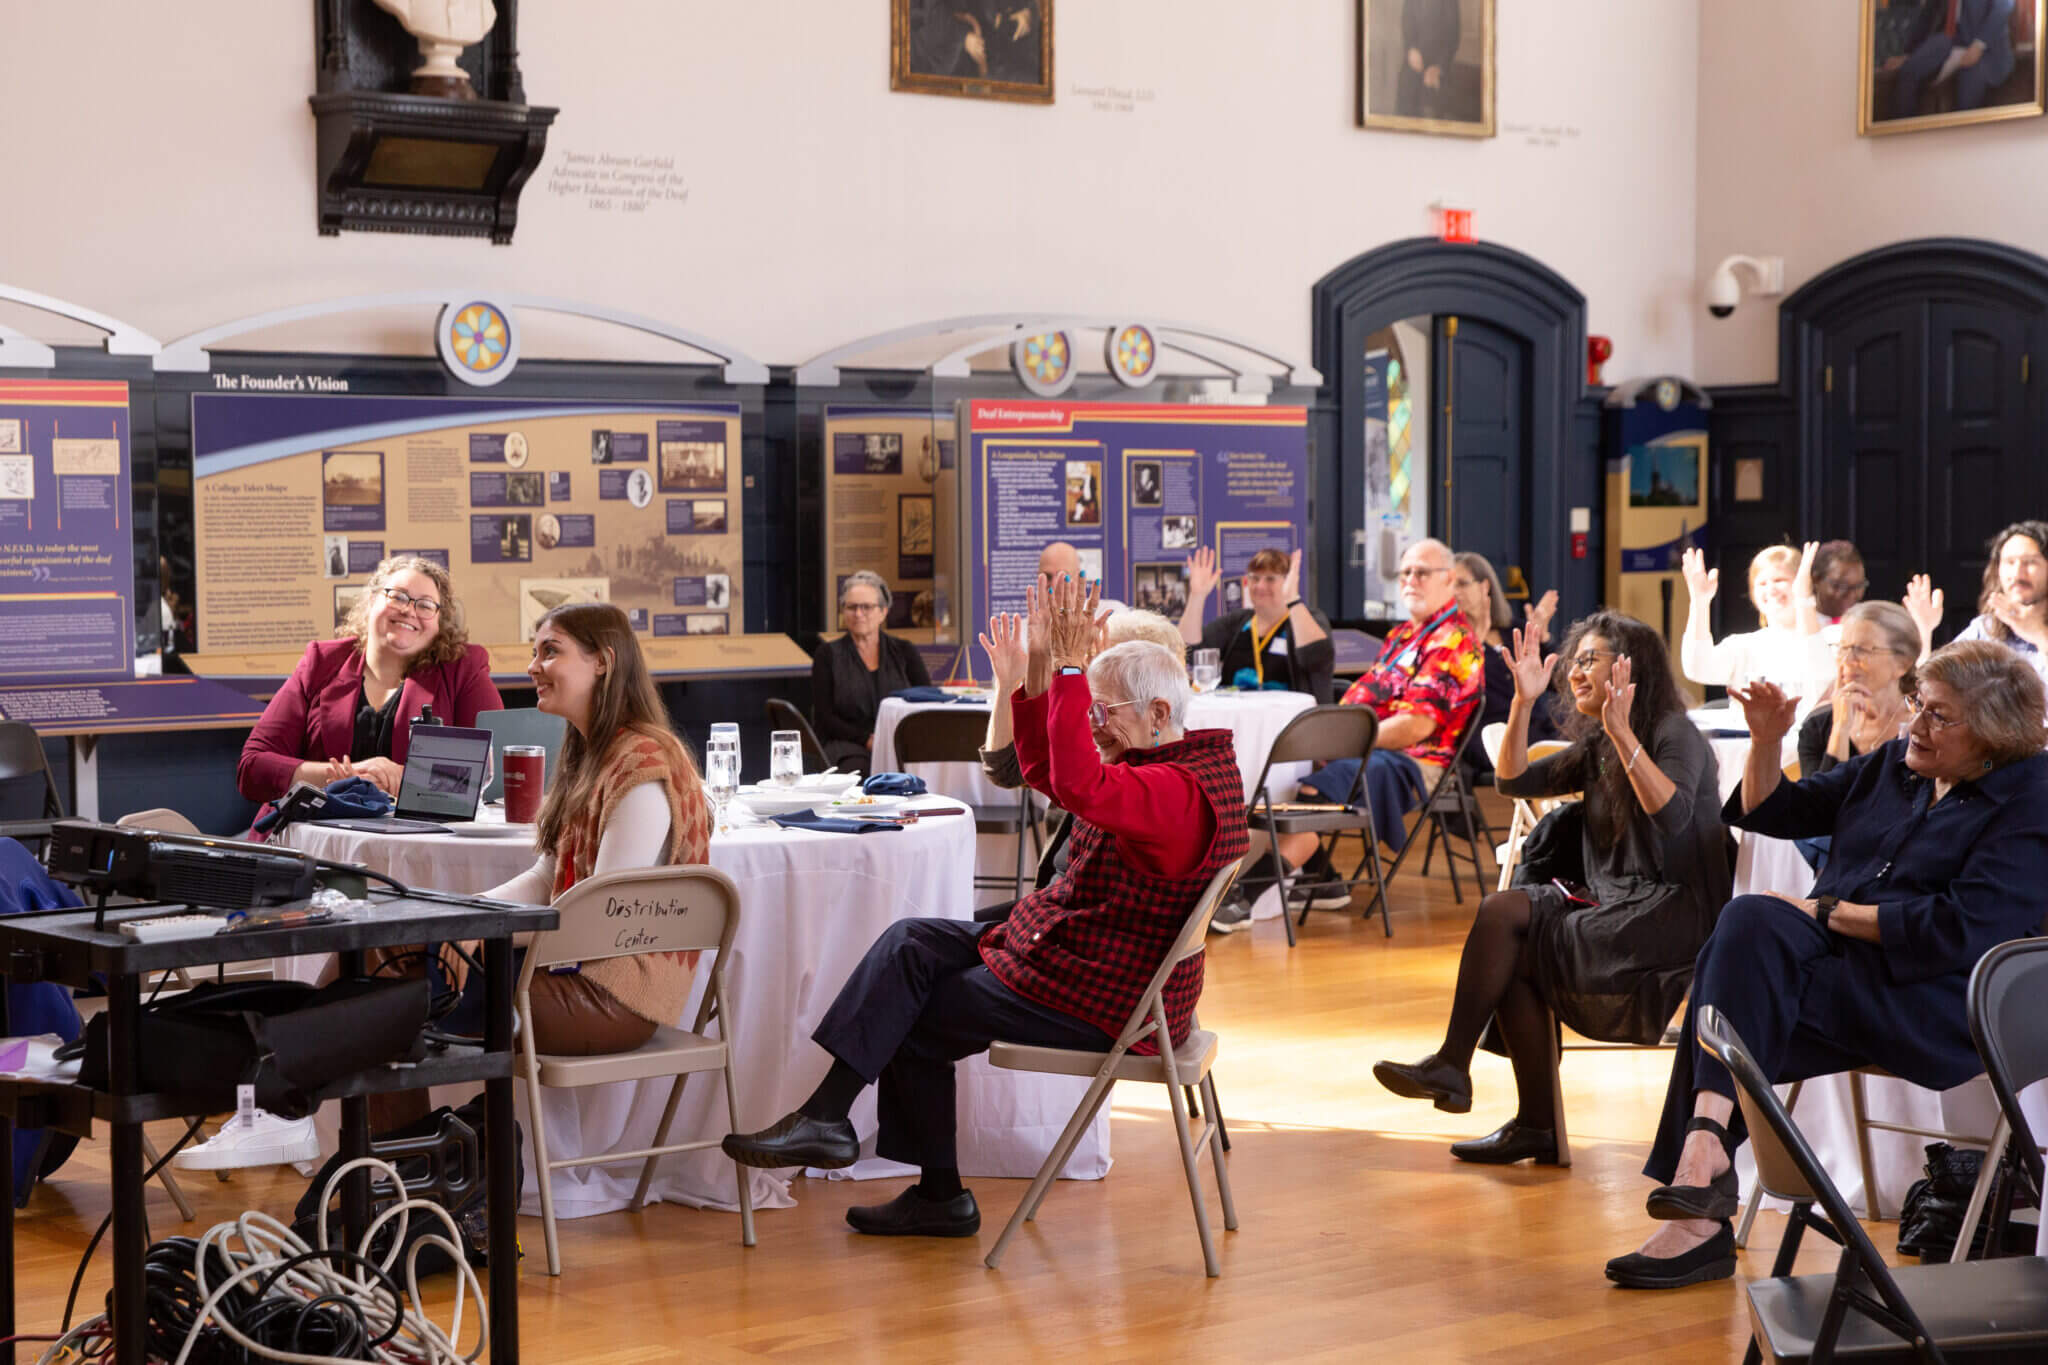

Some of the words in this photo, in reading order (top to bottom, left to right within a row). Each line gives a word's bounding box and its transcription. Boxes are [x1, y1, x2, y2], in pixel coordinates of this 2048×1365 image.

[213, 373, 239, 389] The
[307, 375, 349, 392] Vision
[605, 896, 689, 918] Distribution
[614, 927, 660, 948] Center
